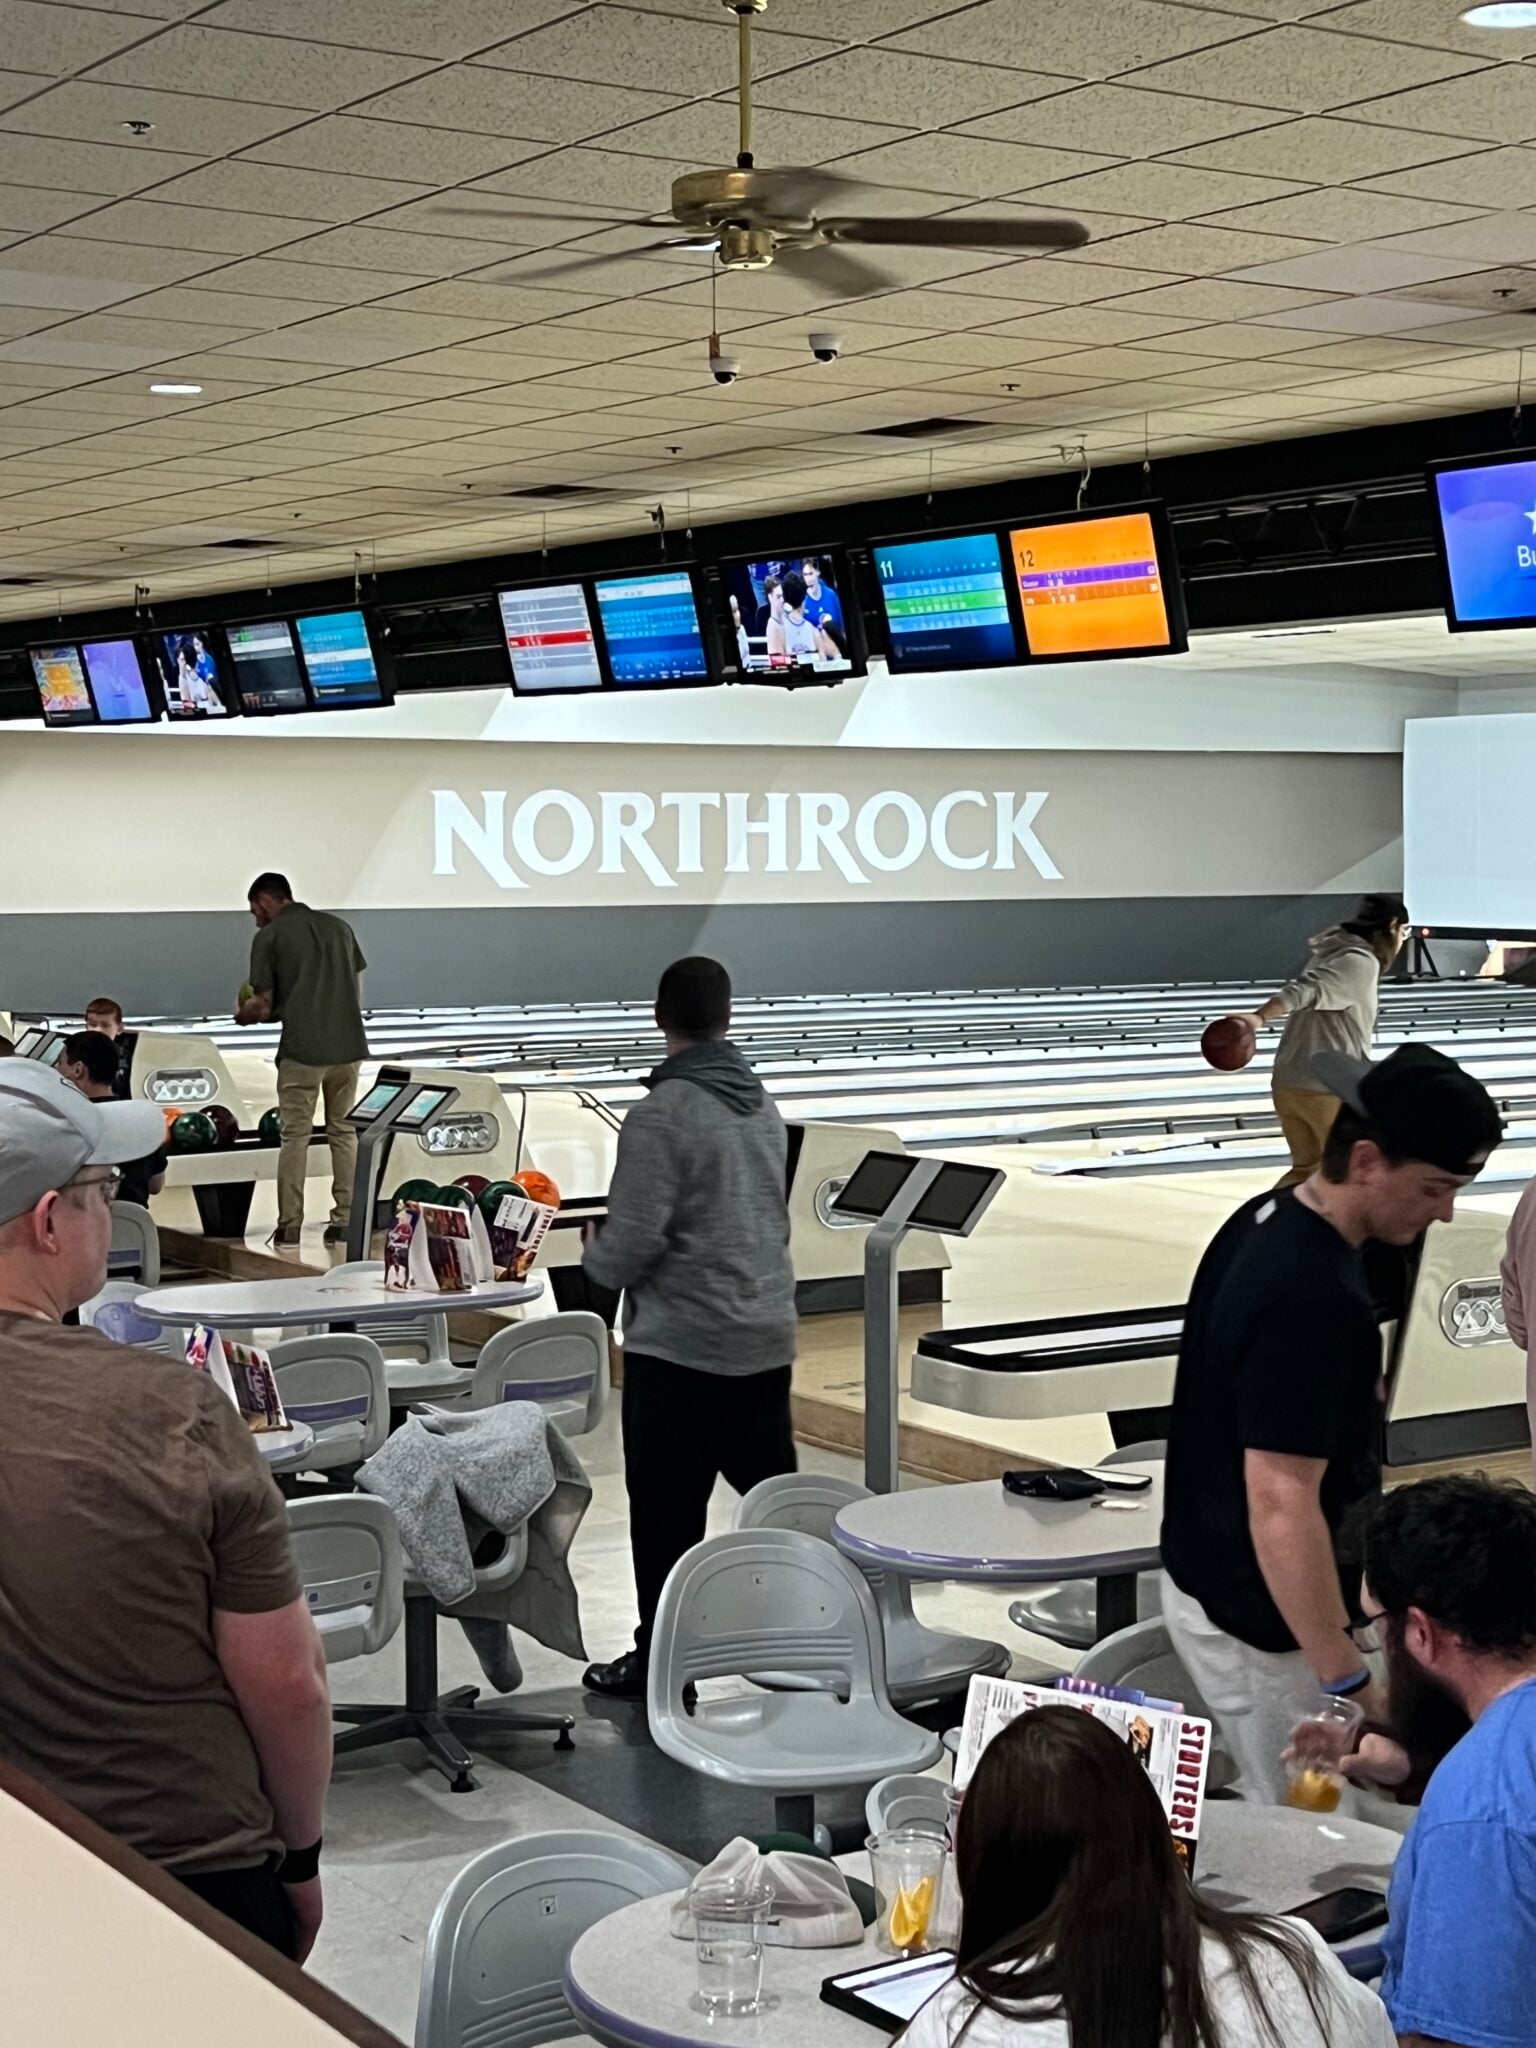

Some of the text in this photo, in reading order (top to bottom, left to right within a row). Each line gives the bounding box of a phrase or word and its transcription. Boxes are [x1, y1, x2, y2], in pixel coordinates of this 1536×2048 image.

[880, 560, 894, 578] 11
[1019, 550, 1034, 567] 12
[431, 789, 1064, 888] NORTHROCK
[152, 1078, 211, 1101] 2000
[1170, 1722, 1206, 1833] STARTERS
